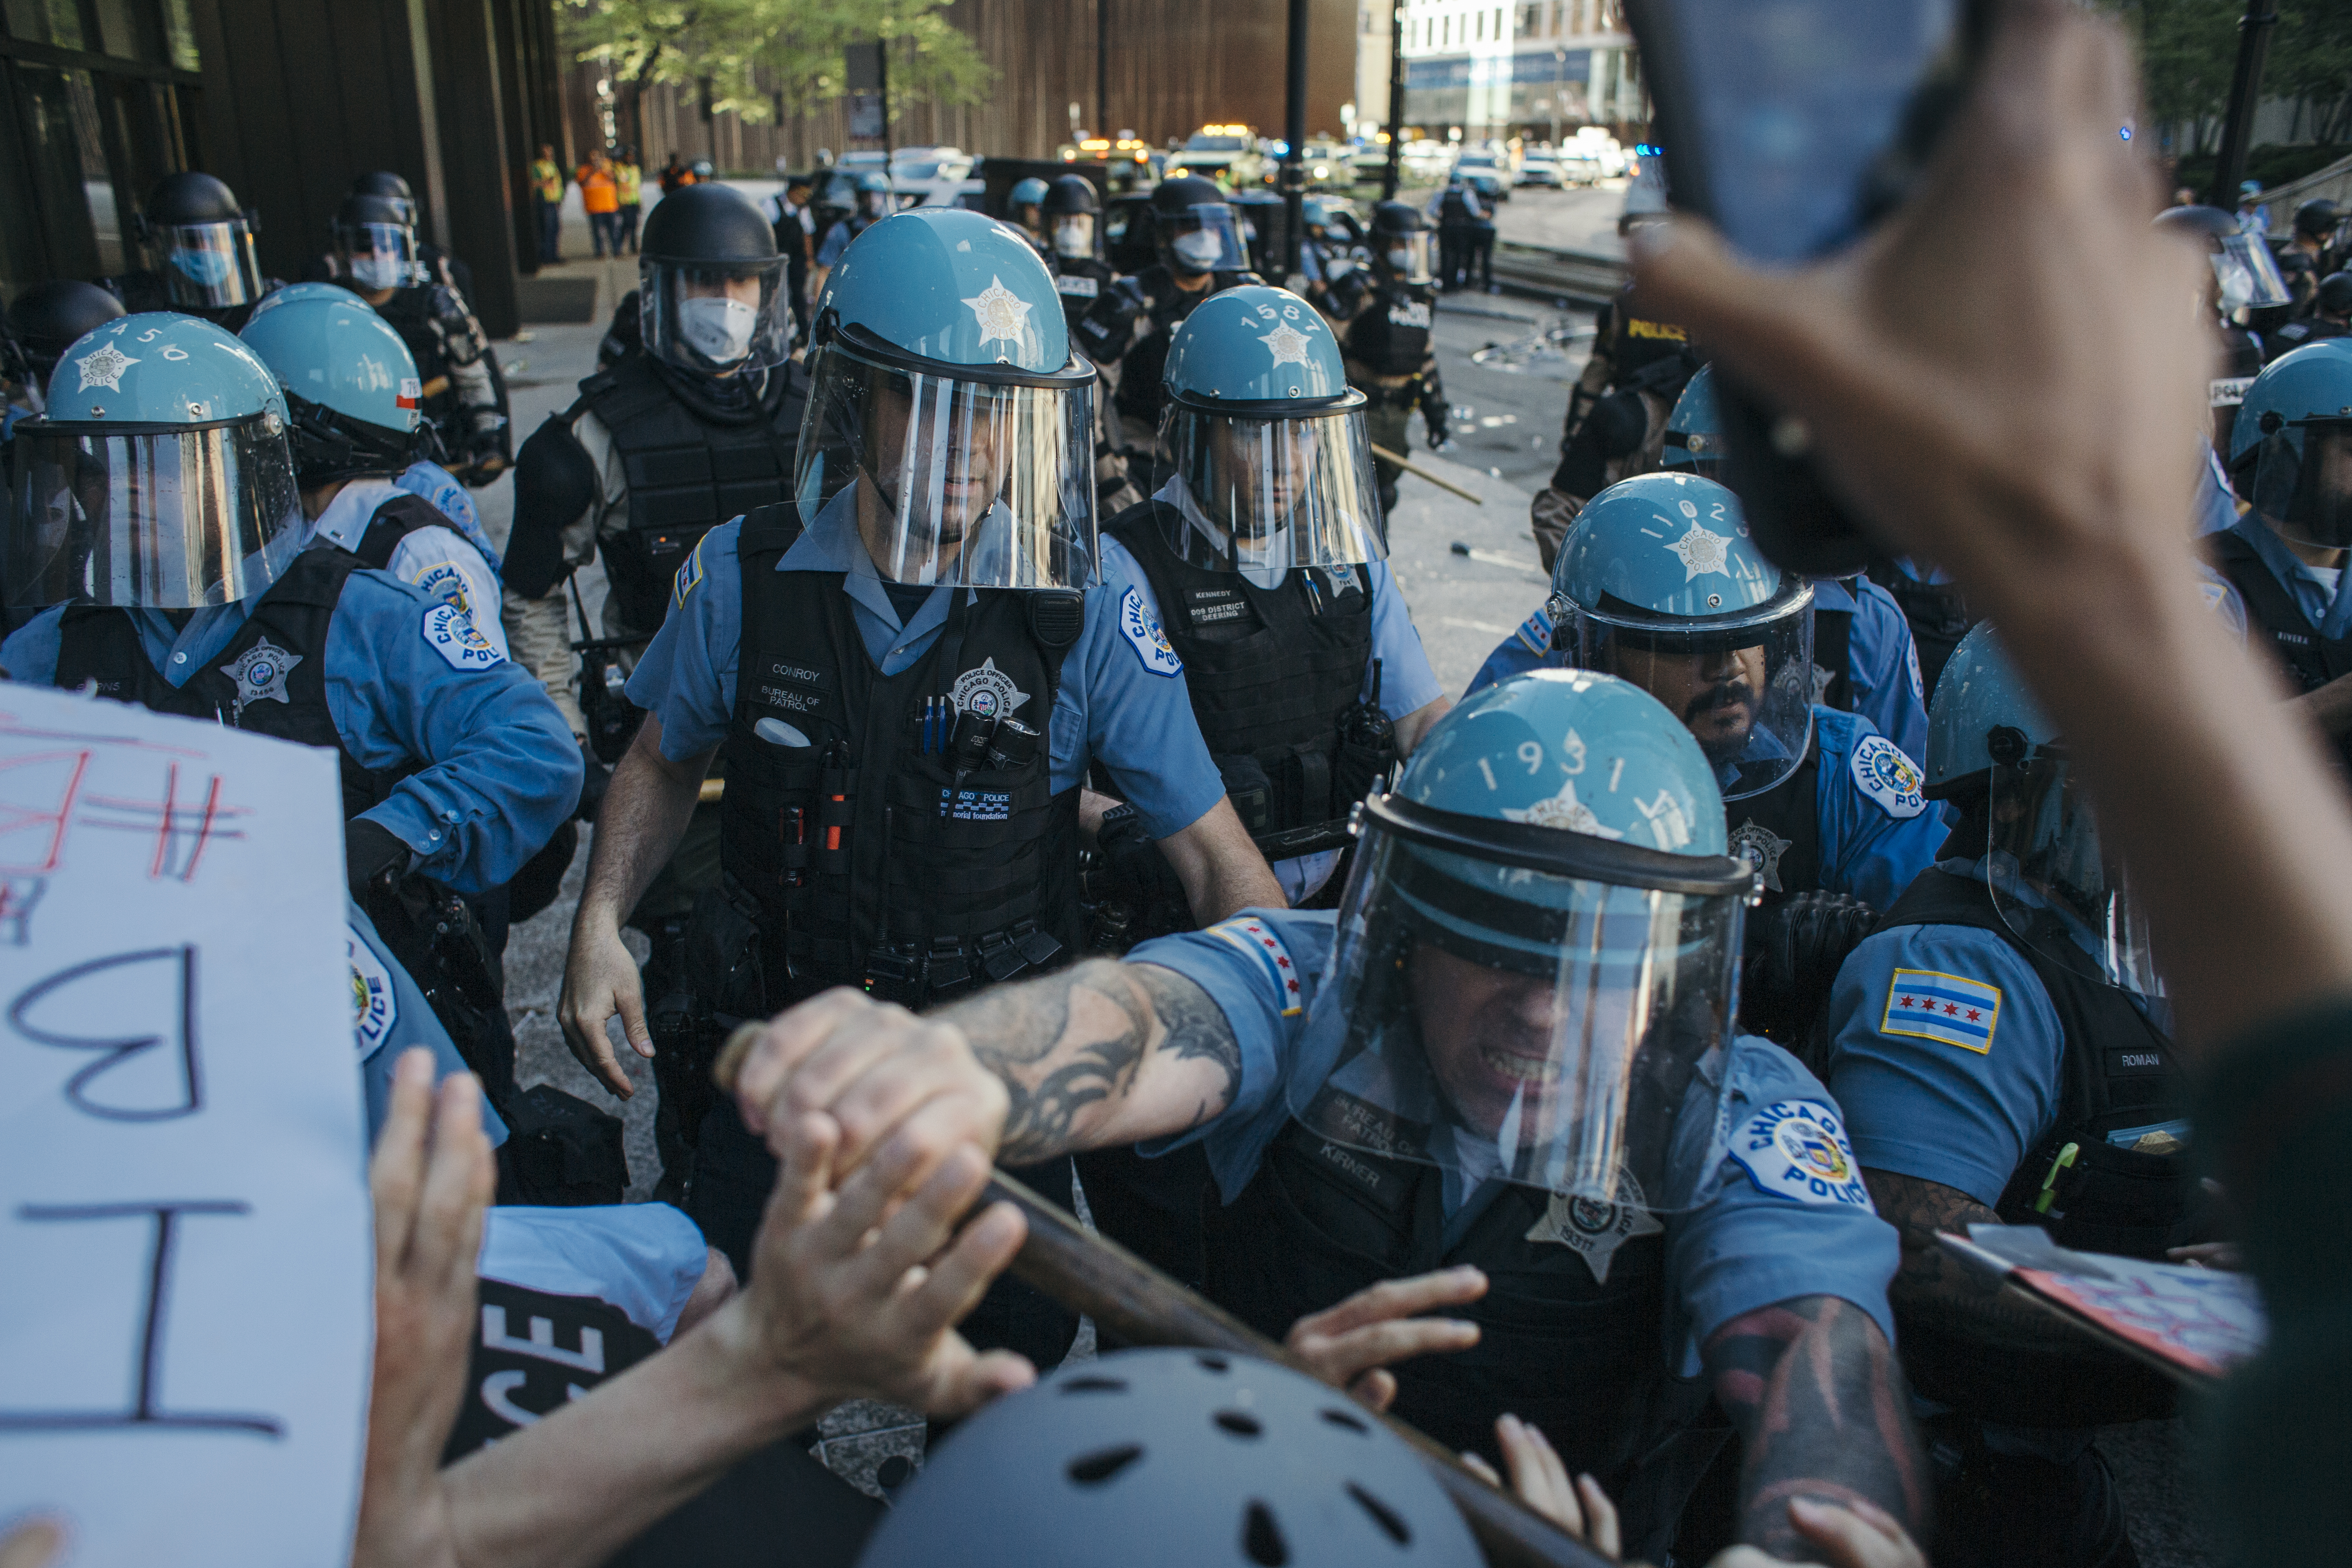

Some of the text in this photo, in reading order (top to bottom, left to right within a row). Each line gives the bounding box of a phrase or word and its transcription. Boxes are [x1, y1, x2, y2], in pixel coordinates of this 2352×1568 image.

[978, 288, 1021, 309] CHICAGO
[1241, 303, 1321, 331] 1587
[982, 321, 1022, 339] POLICE
[1270, 327, 1303, 342] CHICAGO
[84, 350, 124, 365] CHICAGO
[1274, 349, 1305, 362] POLICE
[82, 373, 119, 386] POLICE
[1679, 530, 1720, 550] CHICAGO
[1686, 555, 1724, 572] POLICE
[1202, 610, 1238, 621] DEERING
[1208, 602, 1245, 613] DISTRICT
[238, 653, 285, 682] CHICAGO POLICE
[773, 664, 820, 682] CONROY
[960, 669, 1013, 689] POLICE OFFICER
[762, 686, 820, 706] BUREAU OF
[769, 696, 808, 711] PATROL
[957, 677, 1011, 714] CHICAGO POLICE
[942, 789, 975, 800] CHAGO
[941, 810, 1008, 820] mmorial foundation
[1756, 835, 1777, 862] POLICE
[2122, 1054, 2160, 1067] ROMAN
[1319, 1143, 1380, 1188] KIRNER
